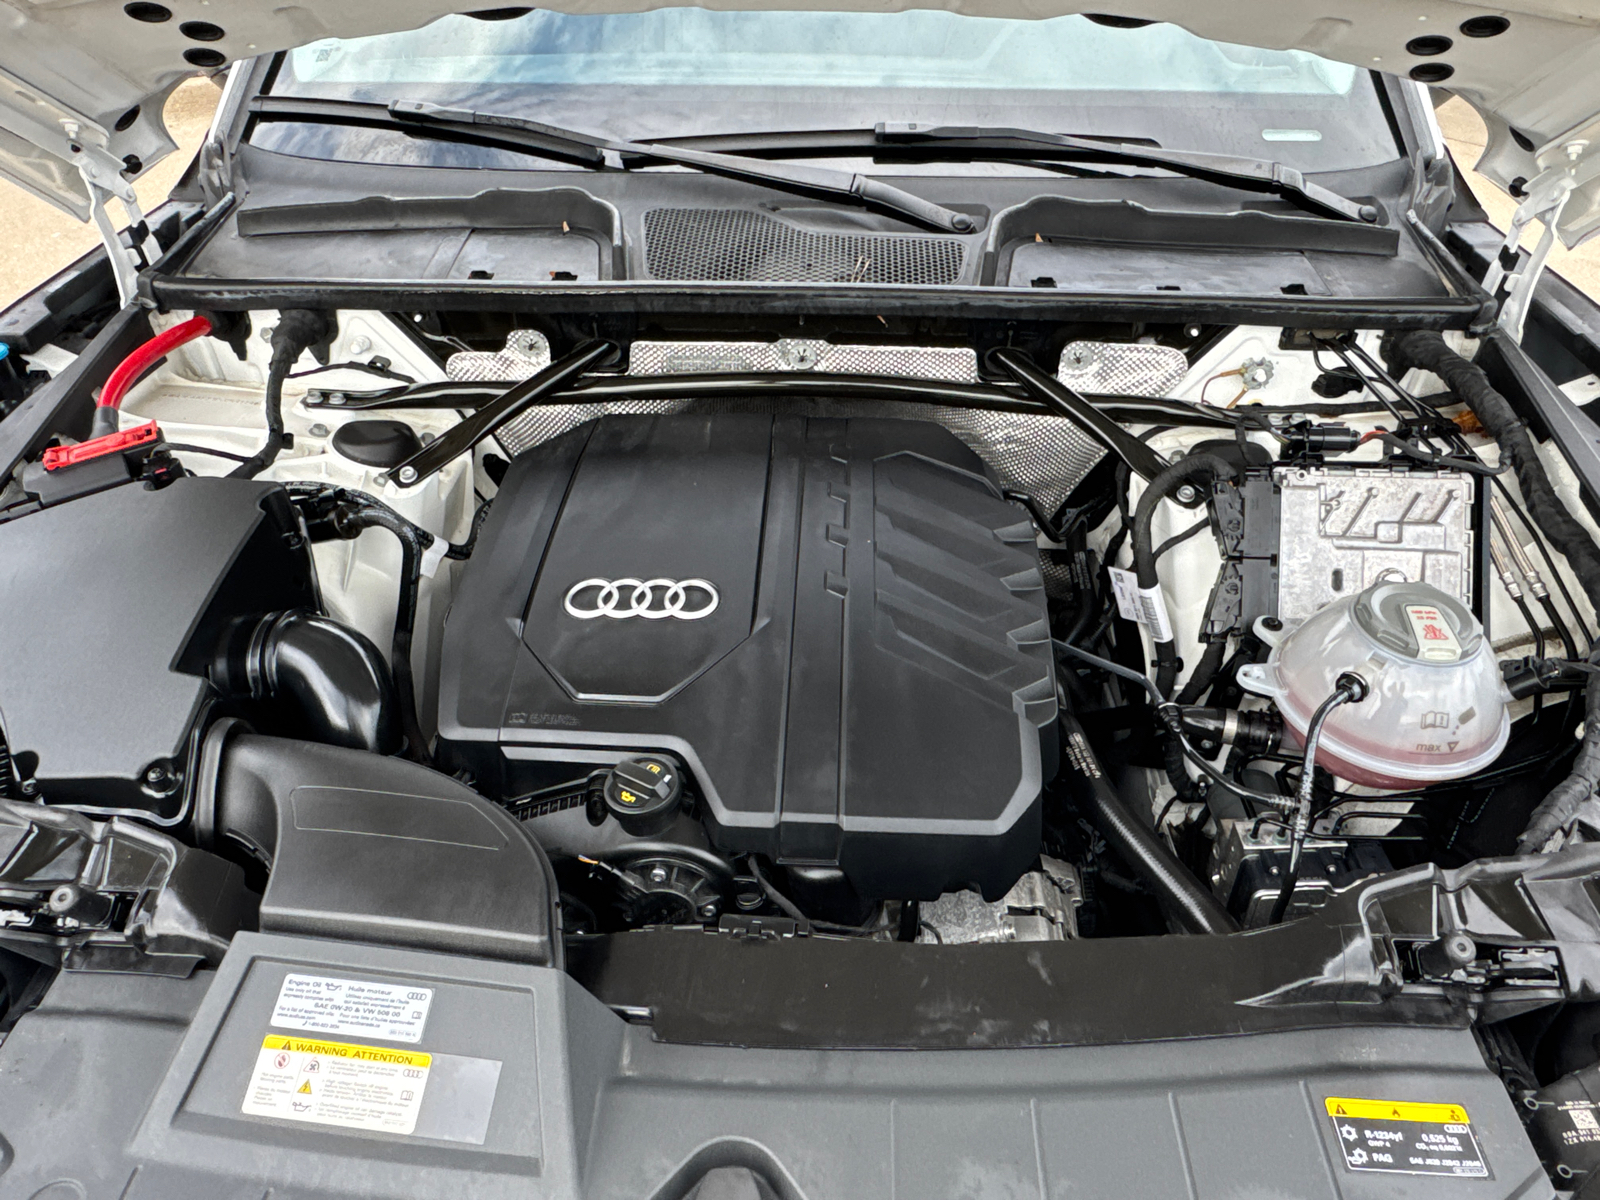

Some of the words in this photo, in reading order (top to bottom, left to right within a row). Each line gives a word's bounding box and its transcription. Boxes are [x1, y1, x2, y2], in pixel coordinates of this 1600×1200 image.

[1416, 743, 1442, 752] max
[296, 1043, 348, 1057] WARNING
[352, 1050, 413, 1064] ATTENTION
[1364, 1130, 1404, 1142] R-1234yf
[1446, 1135, 1459, 1146] kg
[1372, 1152, 1394, 1163] PAG
